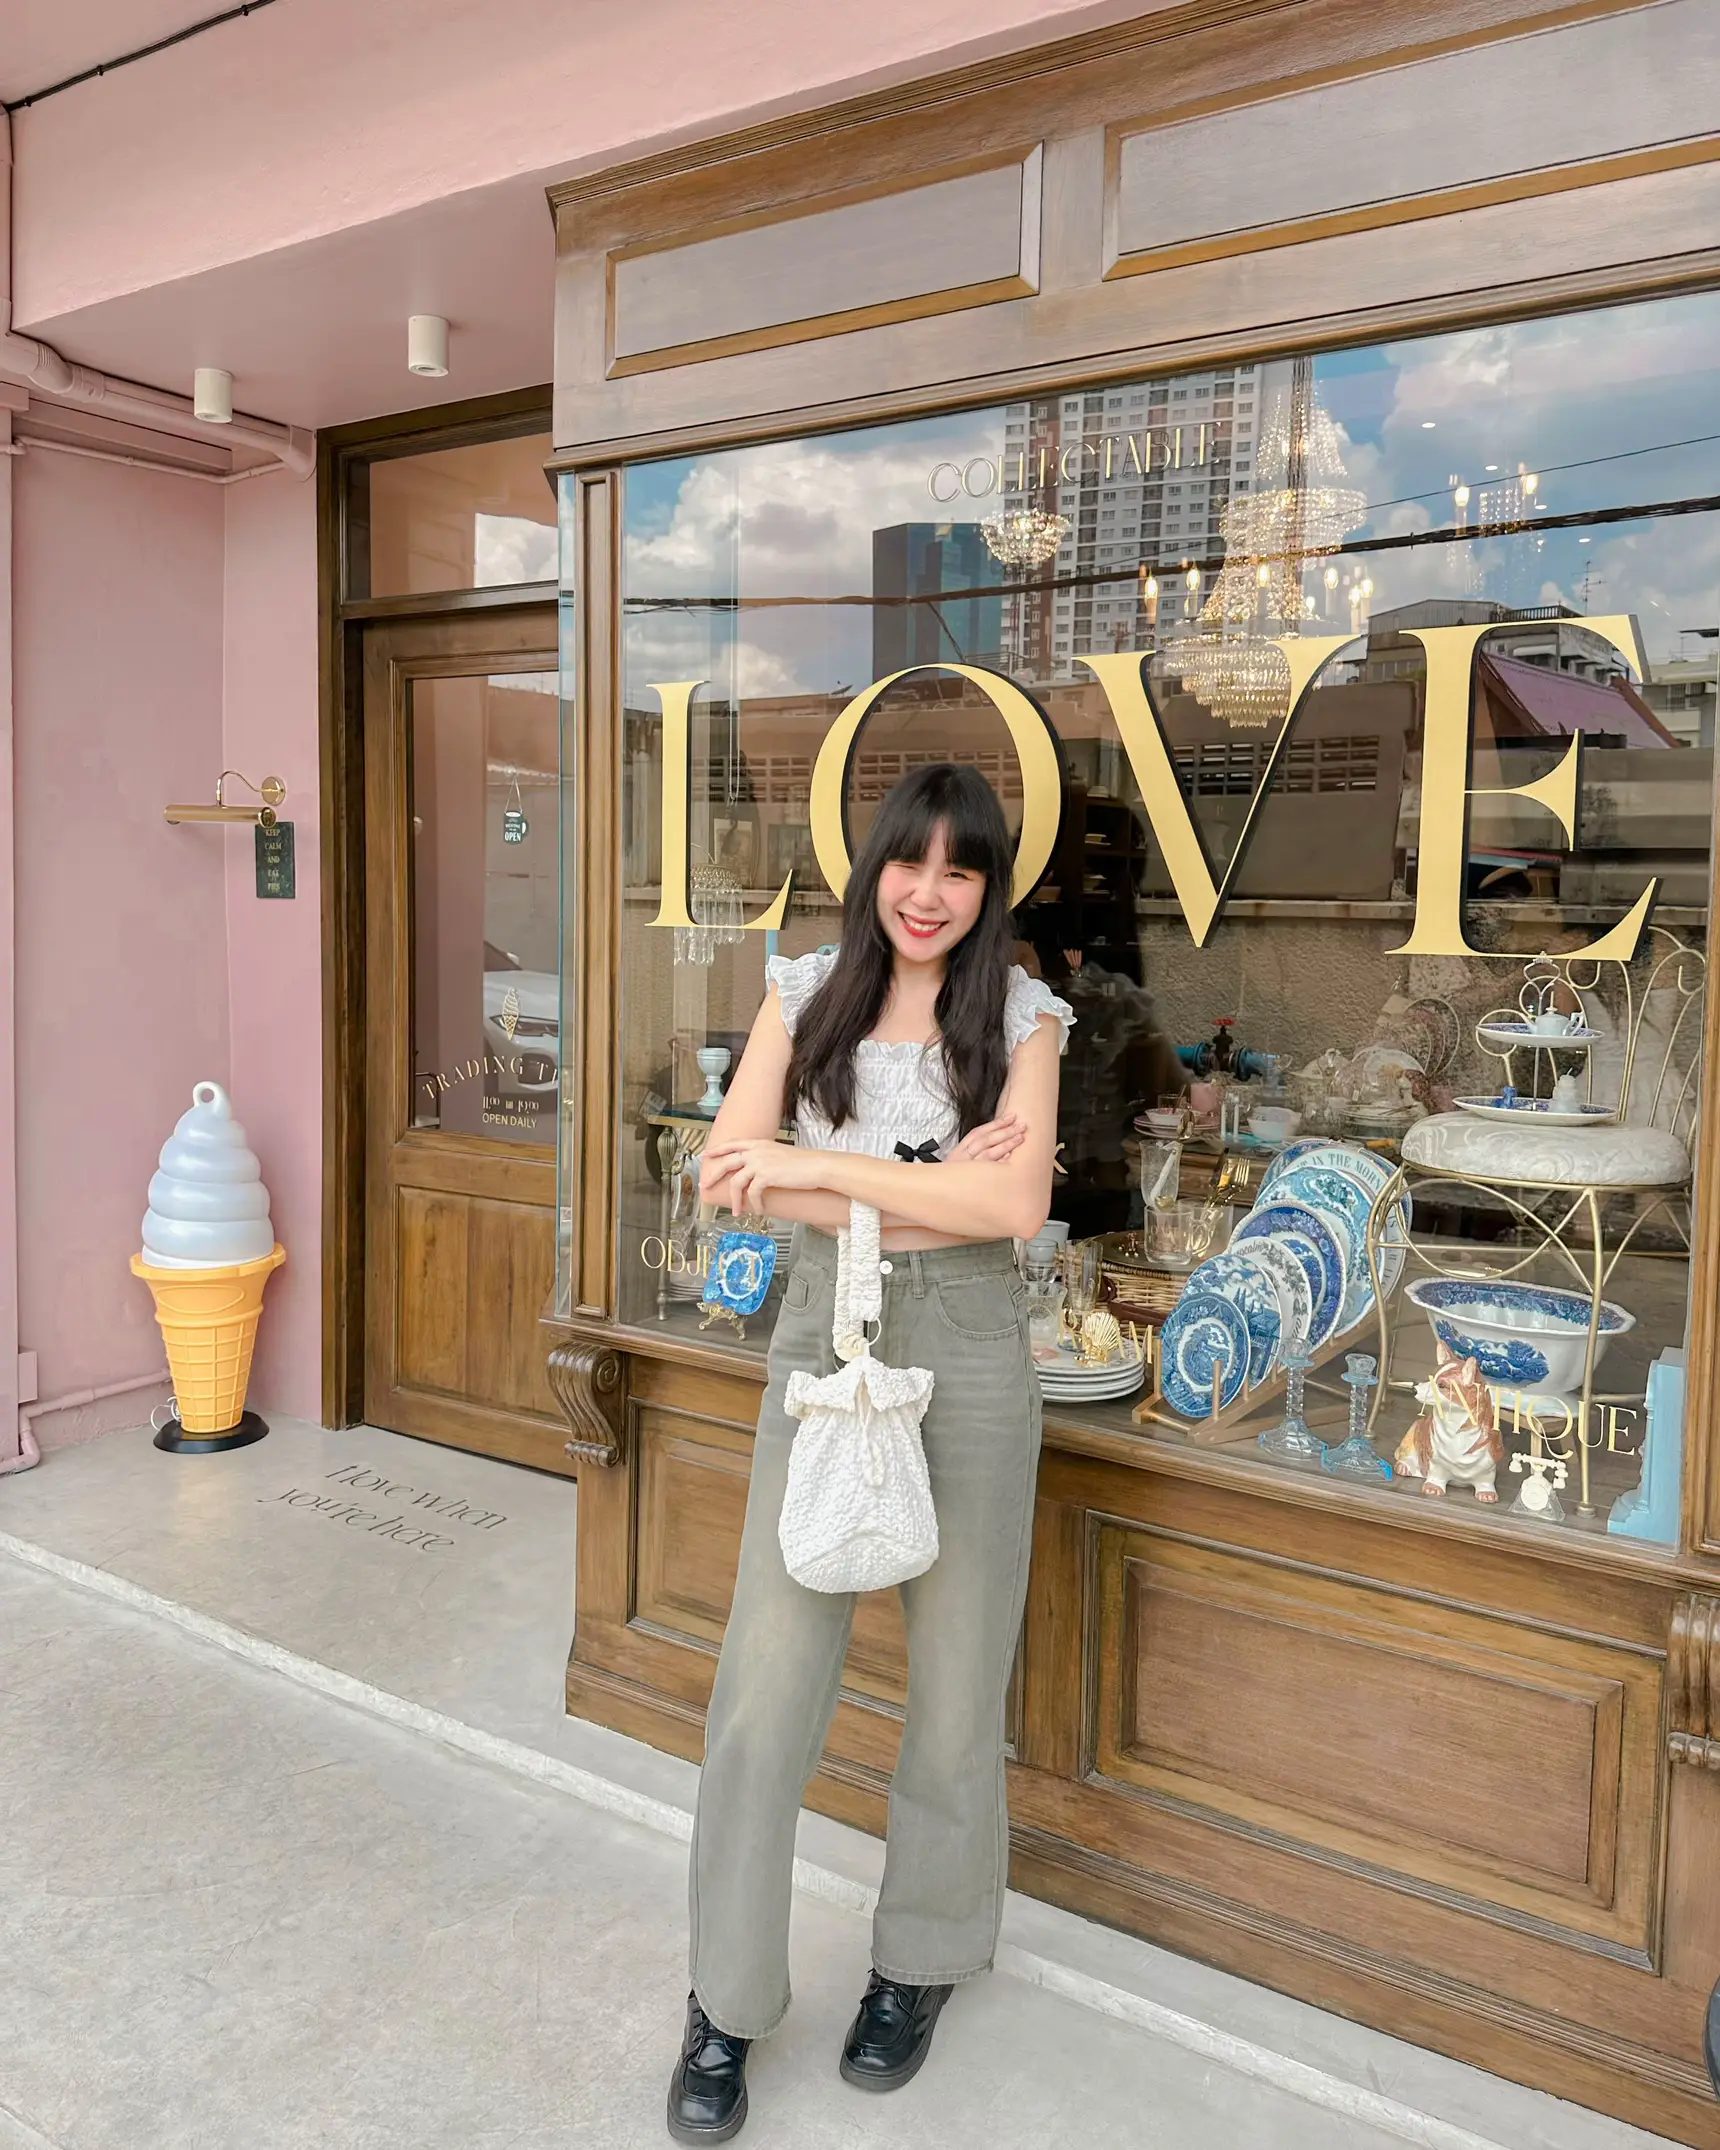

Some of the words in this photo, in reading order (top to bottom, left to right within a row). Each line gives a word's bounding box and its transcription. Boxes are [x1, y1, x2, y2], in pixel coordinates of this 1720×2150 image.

[927, 422, 1221, 502] COLLECTABLE
[645, 614, 1662, 962] LOVE
[264, 842, 282, 850] CALM
[504, 832, 521, 841] OPEN
[422, 1055, 524, 1099] TRADING
[482, 1112, 508, 1126] OPEN
[510, 1115, 538, 1129] DAILY
[1327, 1152, 1353, 1168] THE
[1417, 1374, 1638, 1460] ANTIQUE
[337, 1468, 415, 1499] love
[411, 1491, 508, 1530] when
[368, 1515, 455, 1553] here
